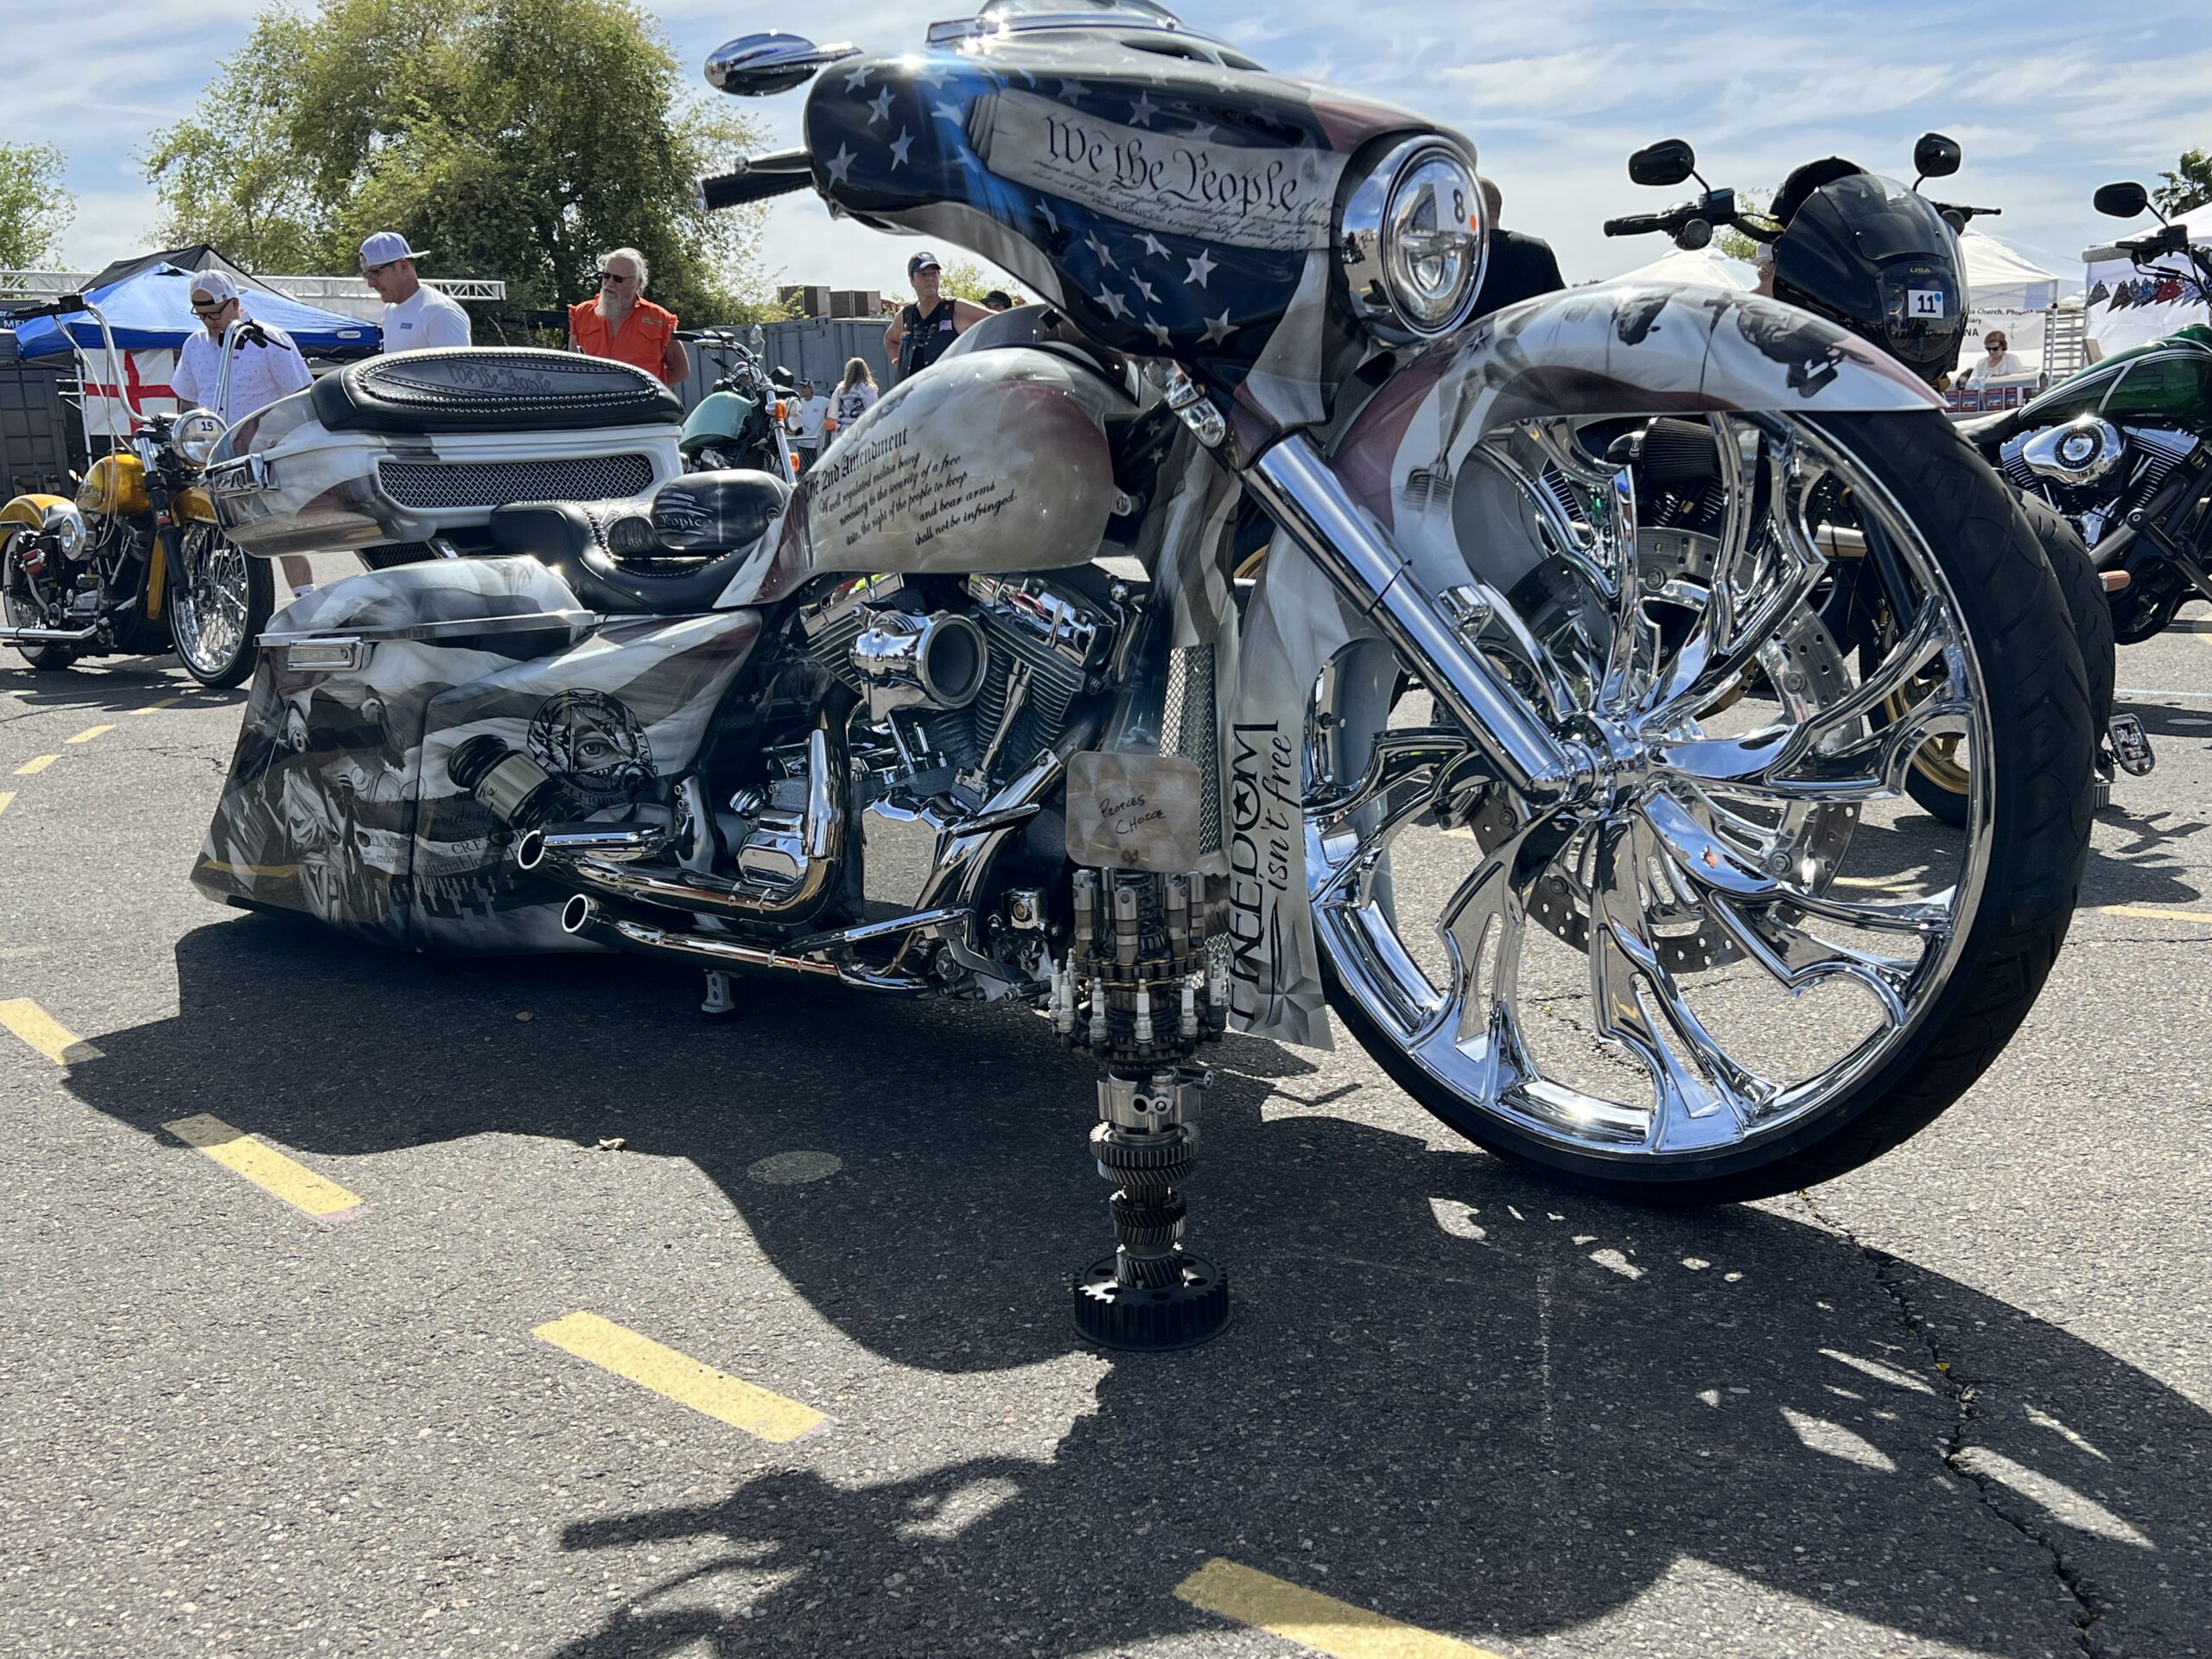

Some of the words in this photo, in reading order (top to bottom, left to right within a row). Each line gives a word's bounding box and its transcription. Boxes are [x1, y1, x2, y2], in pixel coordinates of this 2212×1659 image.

[1041, 112, 1105, 175] We
[1109, 138, 1168, 191] the
[1162, 149, 1298, 219] People
[1452, 188, 1466, 224] 8
[1916, 295, 1936, 313] 11
[1977, 308, 2005, 316] Church,
[444, 361, 475, 385] We
[475, 365, 501, 389] the
[498, 368, 556, 395] People
[201, 421, 213, 432] 15
[804, 479, 820, 500] The
[822, 463, 840, 492] 2nd
[842, 426, 908, 478] Amendment
[830, 492, 842, 512] well
[842, 473, 872, 508] regulated
[873, 464, 896, 484] militia
[898, 452, 920, 470] being
[839, 502, 868, 527] necessary
[869, 495, 876, 506] to
[877, 486, 888, 502] the
[888, 472, 918, 495] security
[920, 460, 932, 484] of
[931, 463, 939, 474] a
[937, 453, 962, 477] free
[656, 515, 702, 530] People
[861, 520, 871, 535] the
[872, 508, 887, 532] right
[888, 499, 896, 523] of
[895, 498, 907, 512] the
[907, 483, 932, 512] people
[933, 481, 944, 493] to
[945, 470, 968, 490] keep
[915, 525, 934, 547] shall
[935, 519, 950, 536] not
[950, 514, 961, 528] be
[963, 488, 1018, 525] infringed.
[919, 500, 938, 523] and
[939, 498, 963, 512] bear
[965, 480, 995, 502] arms
[1261, 734, 1301, 809] free
[1115, 809, 1167, 835] CHOICE
[1258, 808, 1289, 893] isn't
[1227, 719, 1279, 1023] FREEDOM
